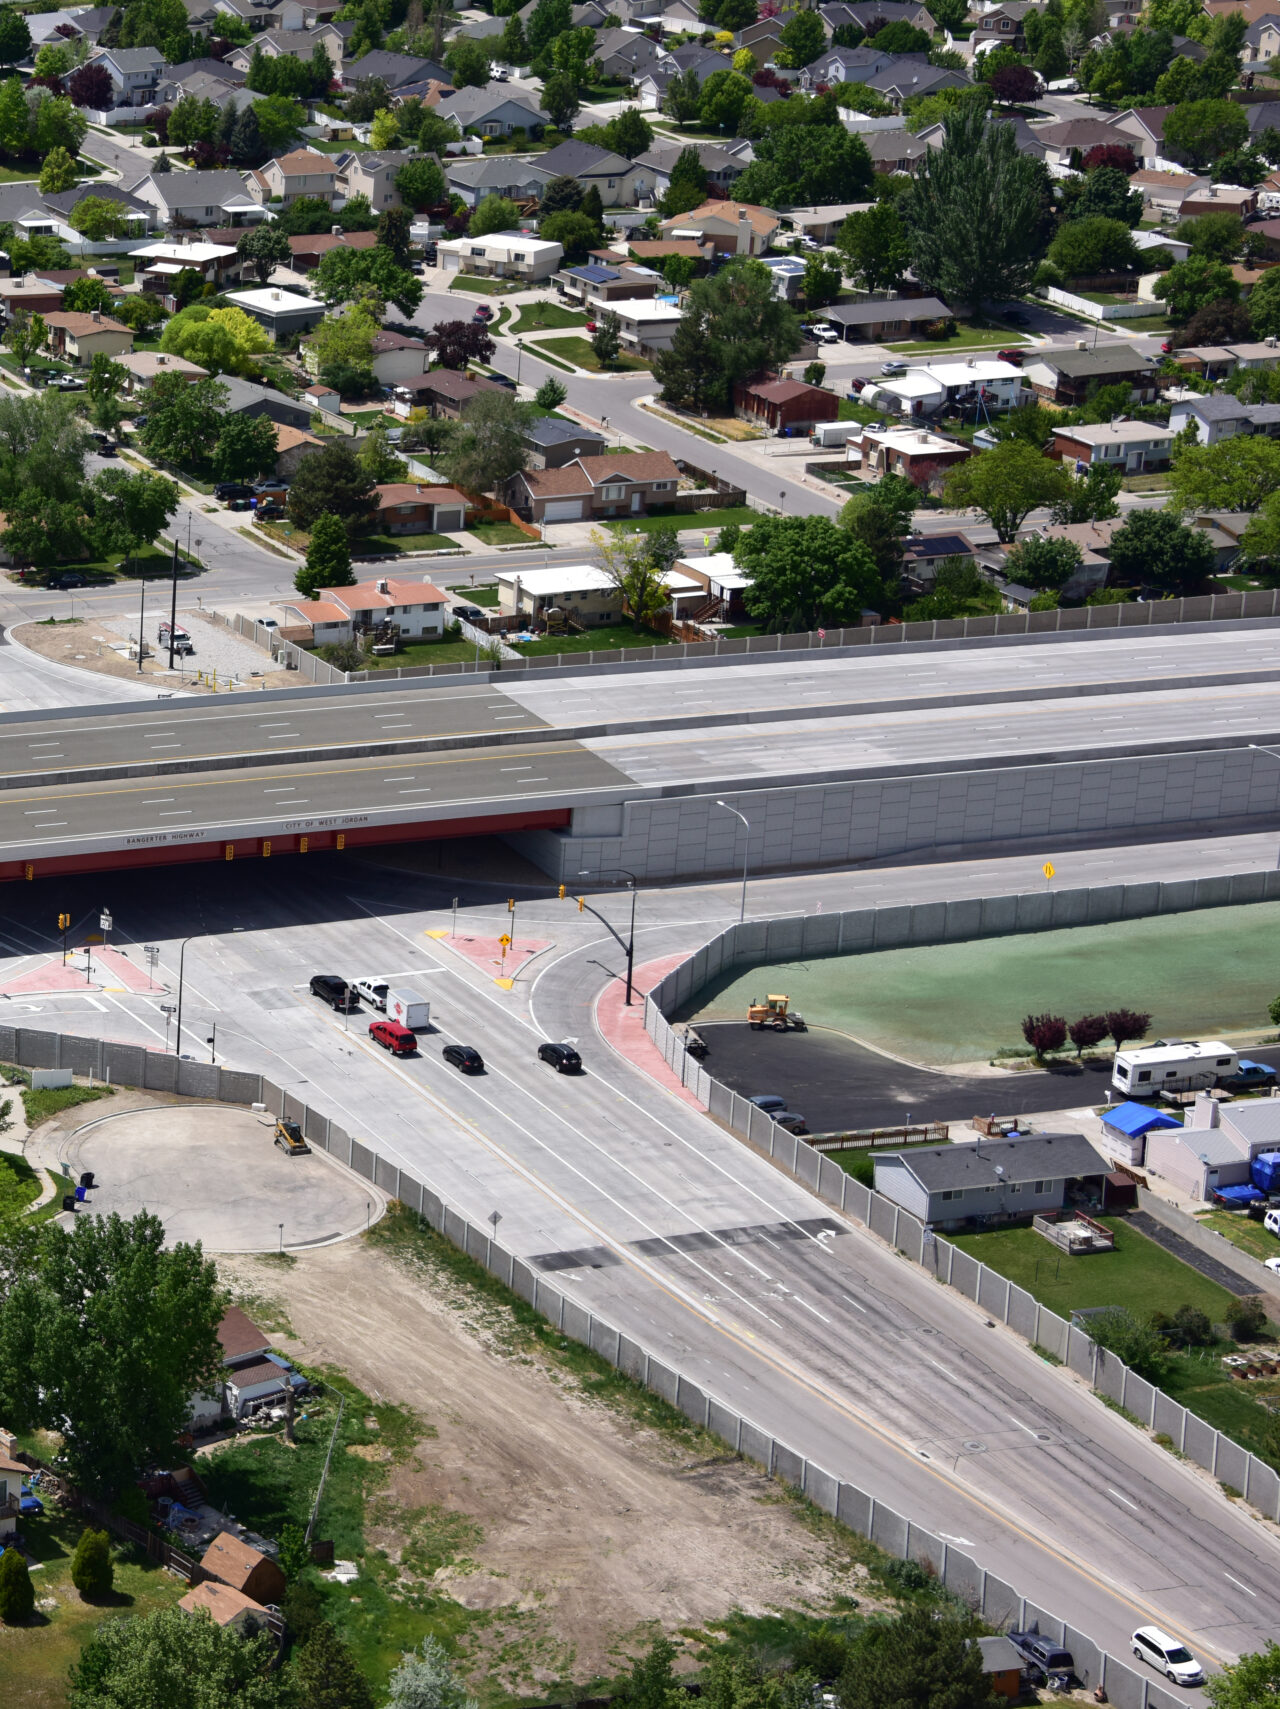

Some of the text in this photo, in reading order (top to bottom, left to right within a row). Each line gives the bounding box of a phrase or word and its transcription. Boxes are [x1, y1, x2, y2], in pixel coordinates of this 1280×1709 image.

[318, 818, 336, 826] WEST
[342, 816, 368, 824] JORDAN
[126, 831, 205, 844] BANGERTER HIGHWAY
